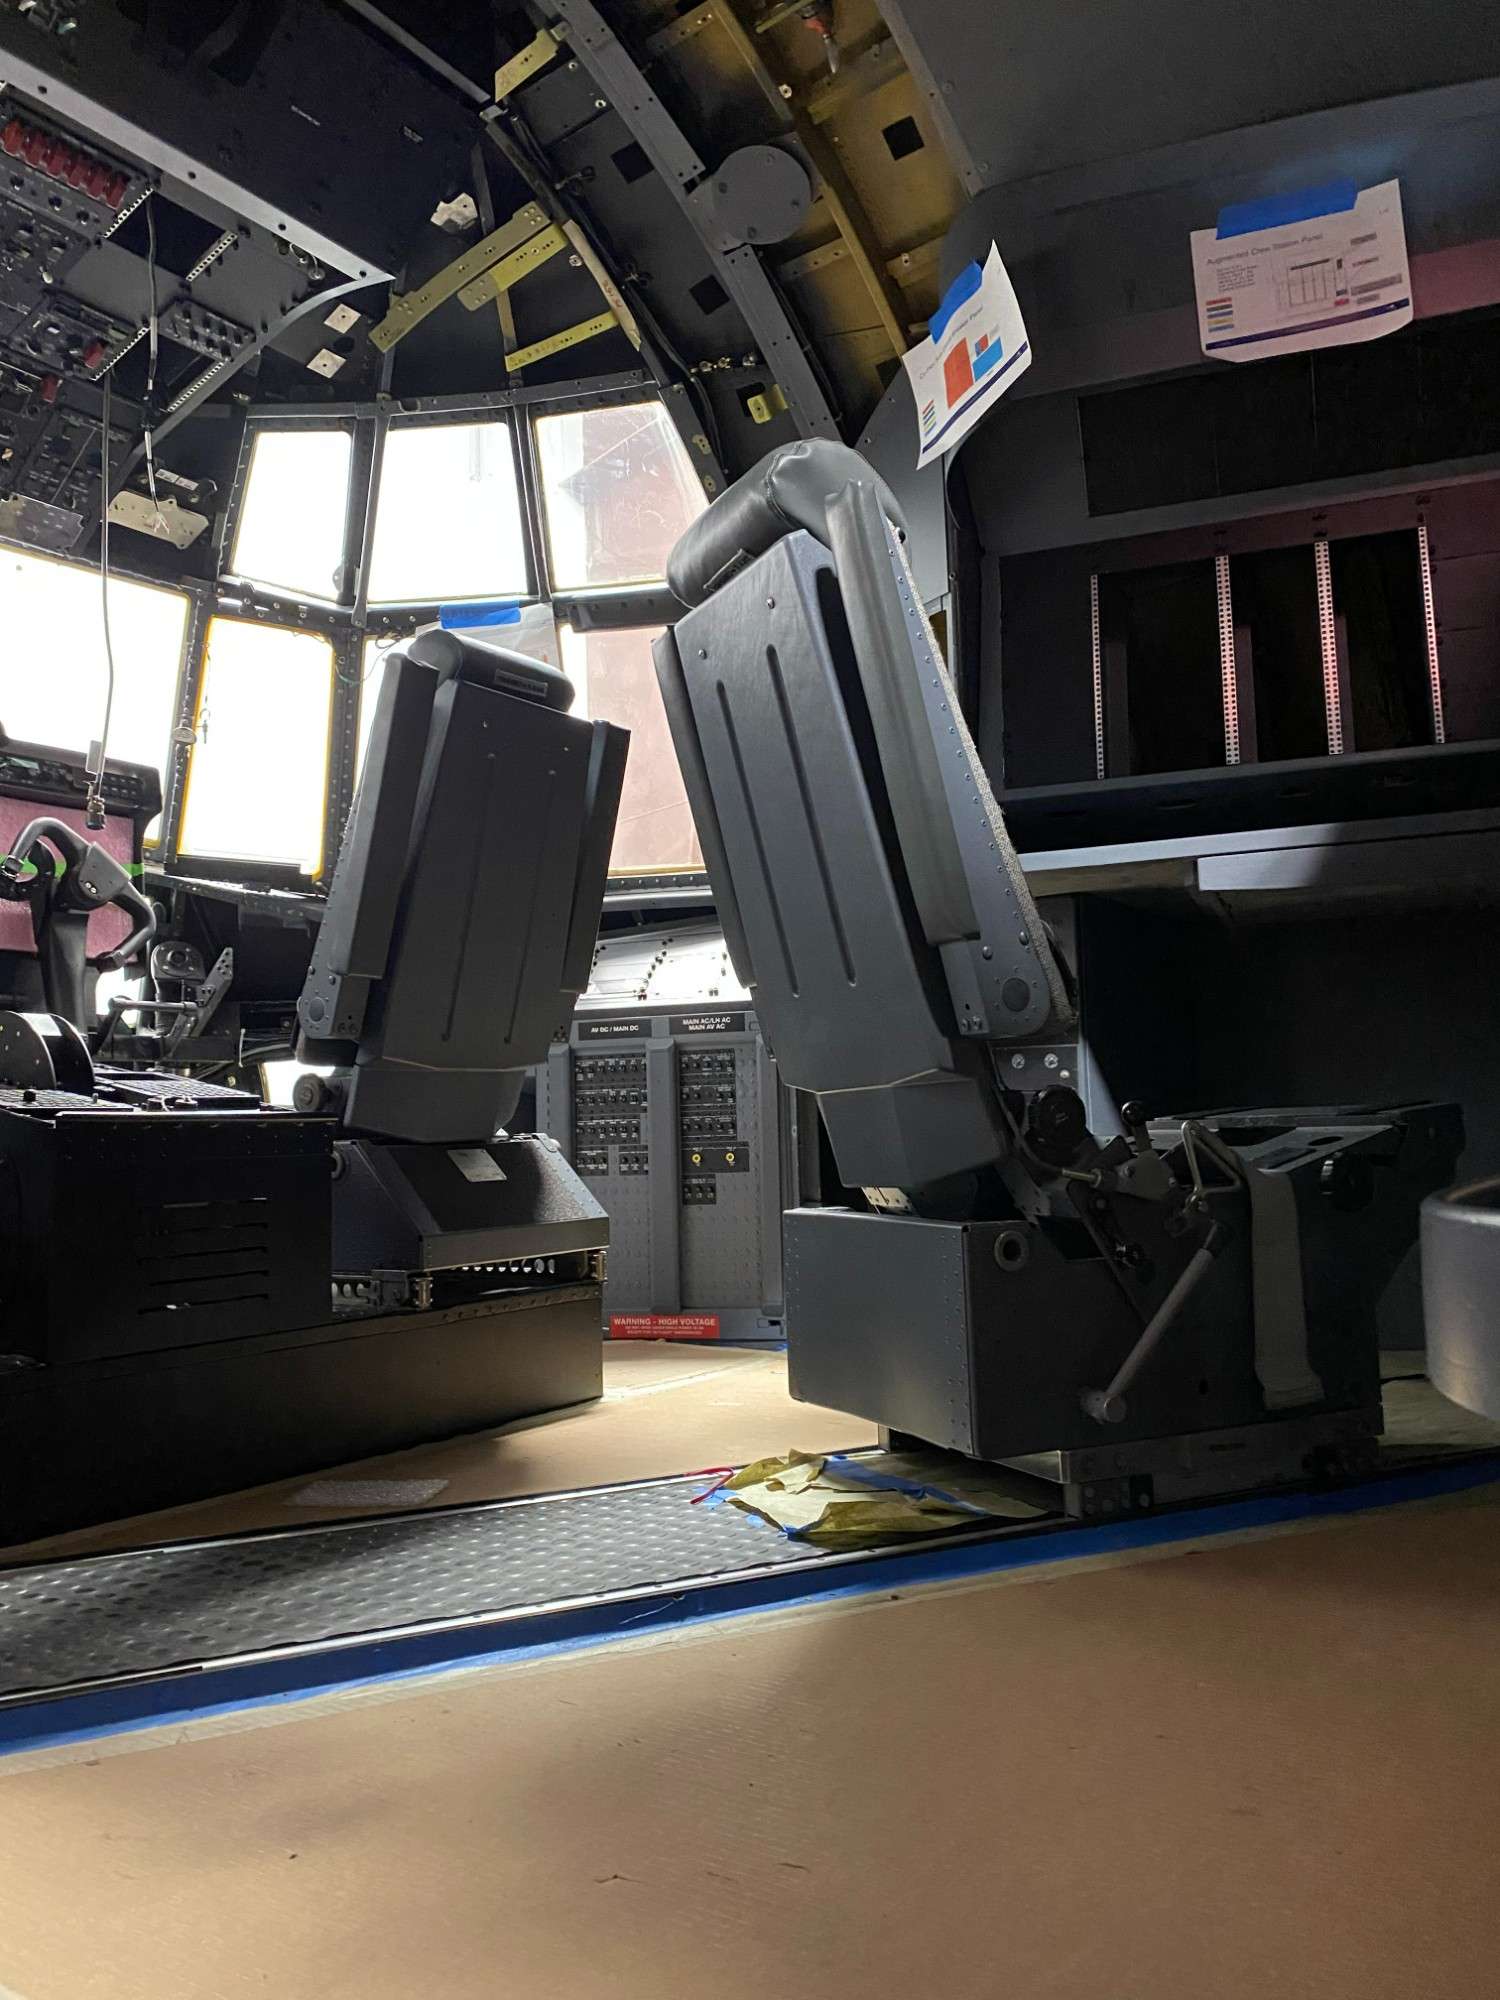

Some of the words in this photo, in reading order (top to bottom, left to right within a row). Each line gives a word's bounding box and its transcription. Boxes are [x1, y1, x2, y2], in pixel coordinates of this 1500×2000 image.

[613, 1318, 651, 1326] WARNING
[658, 1318, 679, 1326] HIGH
[680, 1318, 716, 1326] VOLTAGE
